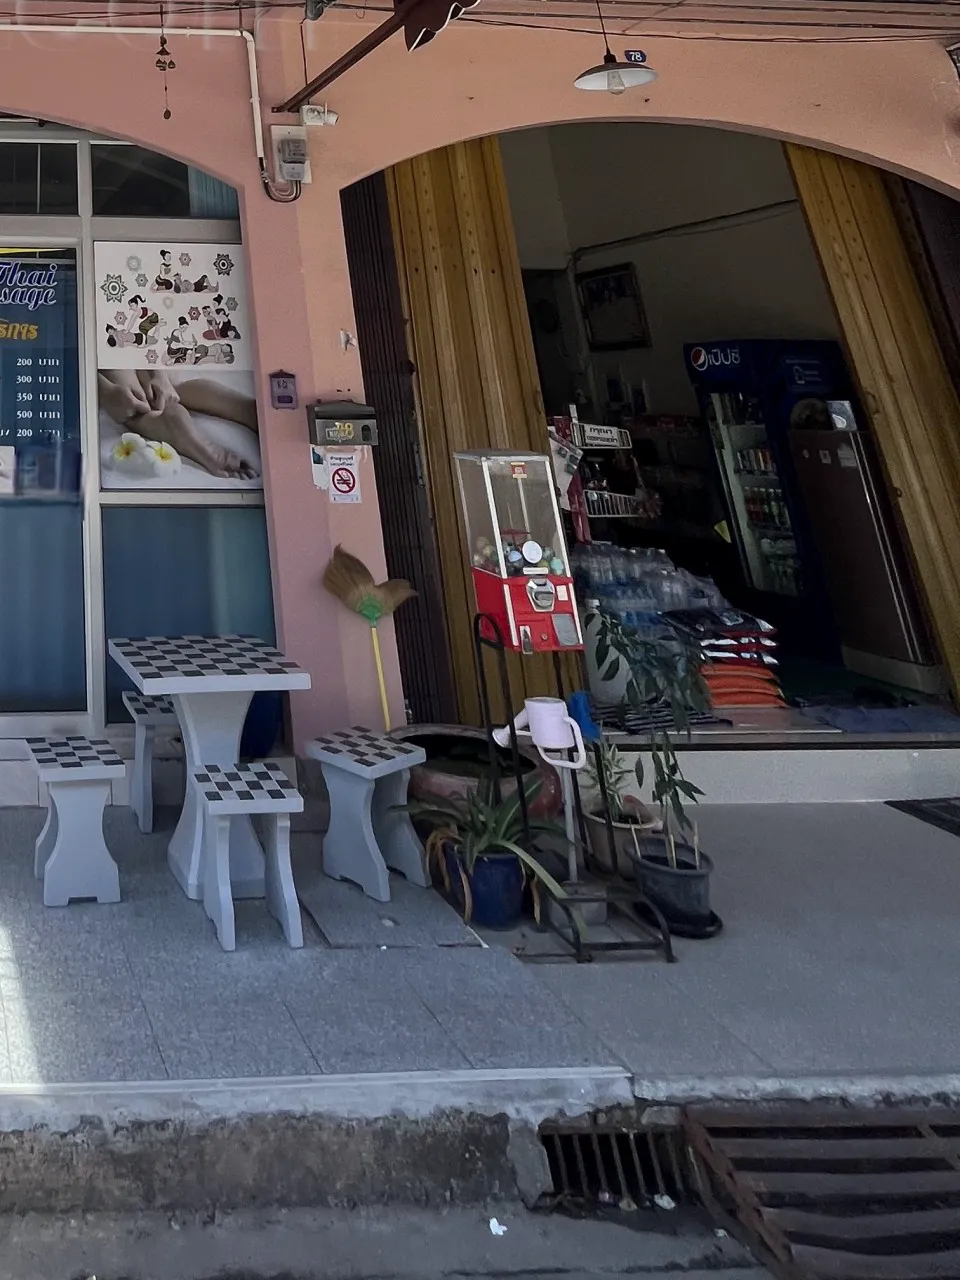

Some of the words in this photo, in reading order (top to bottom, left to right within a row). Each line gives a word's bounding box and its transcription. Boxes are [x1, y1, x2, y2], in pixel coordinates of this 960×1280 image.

[629, 51, 643, 61] 78
[16, 358, 33, 366] 200
[39, 358, 60, 366] บาท
[16, 375, 33, 384] 300
[39, 375, 60, 383] บาท
[16, 393, 33, 401] 350
[39, 393, 60, 401] บาท
[16, 411, 33, 419] 500
[39, 411, 60, 419] บาท
[16, 428, 33, 437] 200
